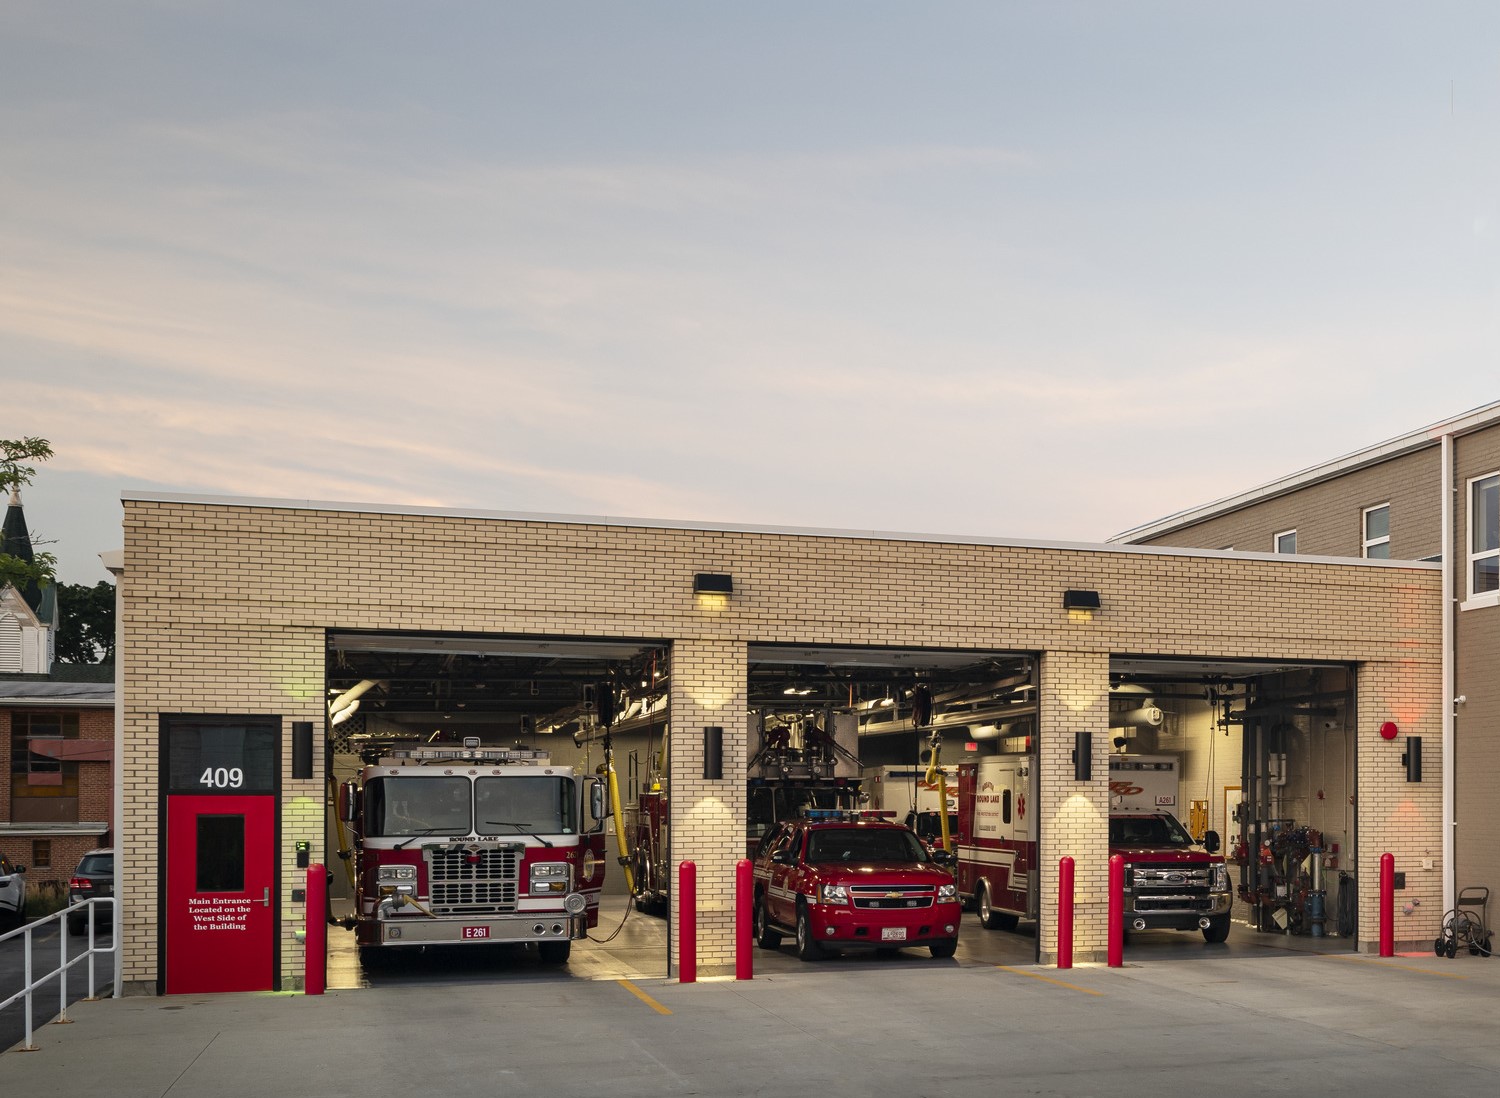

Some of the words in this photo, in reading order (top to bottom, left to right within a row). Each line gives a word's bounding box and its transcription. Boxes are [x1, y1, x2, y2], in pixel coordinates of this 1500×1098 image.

[200, 767, 243, 788] 409
[210, 923, 246, 931] Building
[466, 928, 472, 937] E
[473, 928, 486, 937] 261
